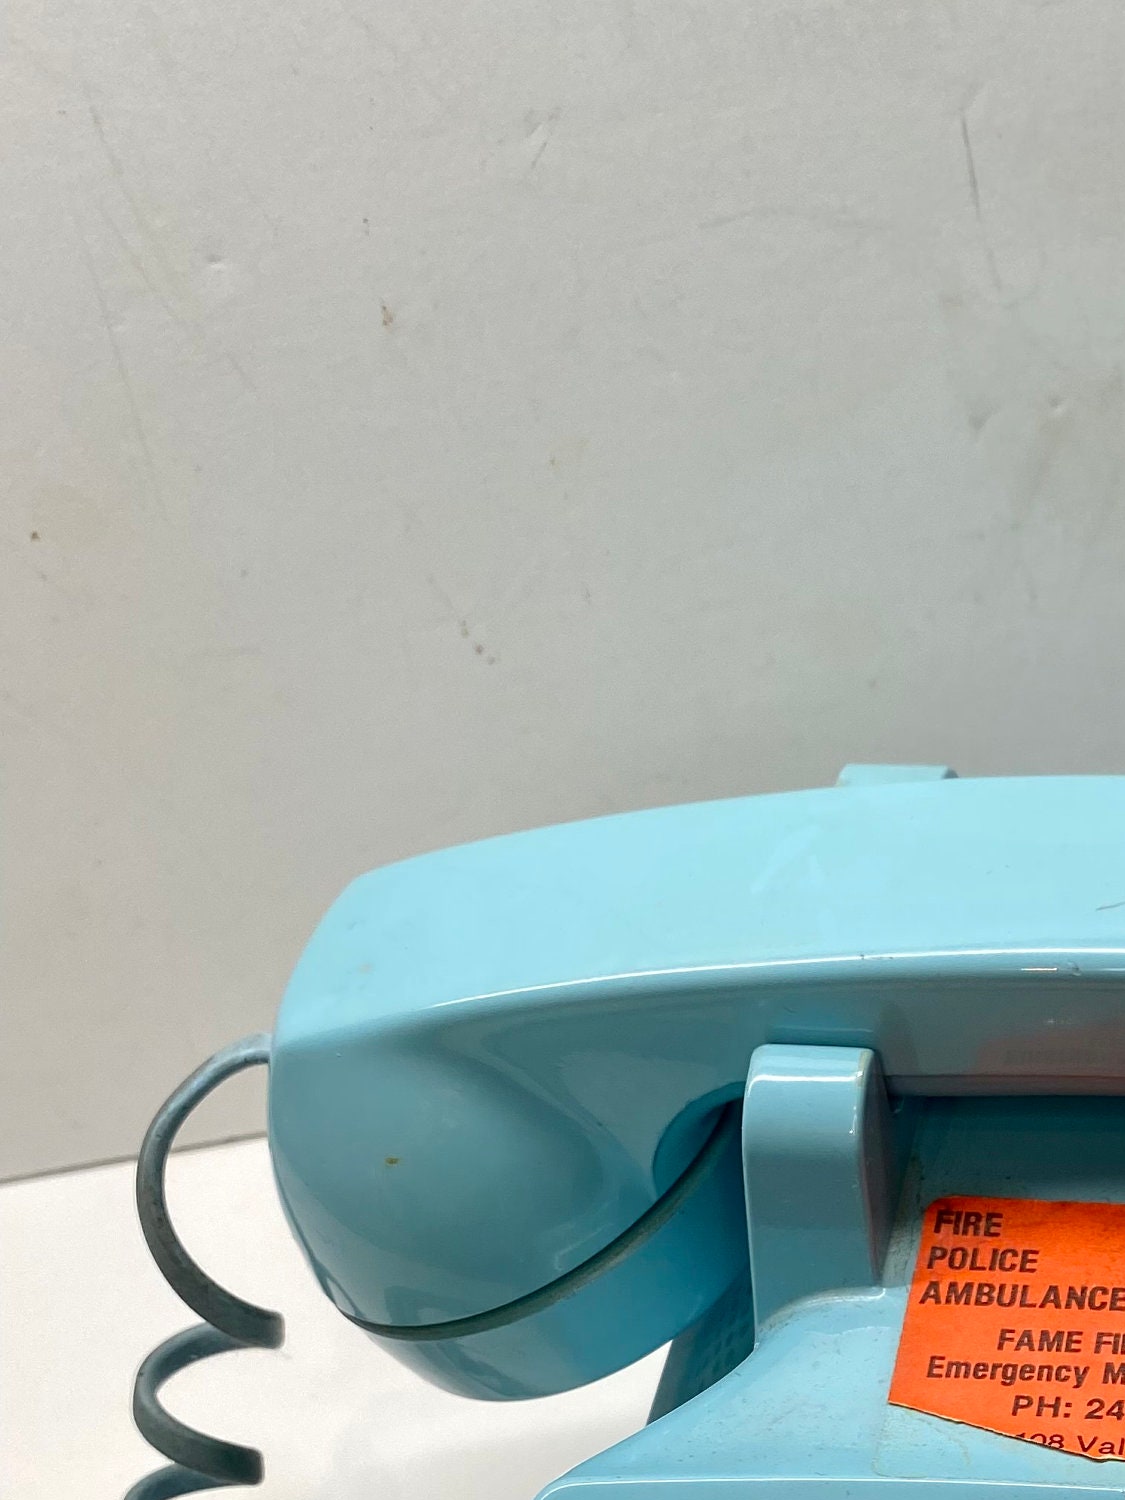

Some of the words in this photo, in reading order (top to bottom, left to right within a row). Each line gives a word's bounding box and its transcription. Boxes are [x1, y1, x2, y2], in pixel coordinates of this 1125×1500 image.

[933, 1210, 1003, 1238] FIRE
[927, 1246, 1040, 1273] POLICE
[997, 1329, 1082, 1354] FAME
[926, 1355, 1090, 1389] Emergency
[1011, 1395, 1072, 1418] PH:
